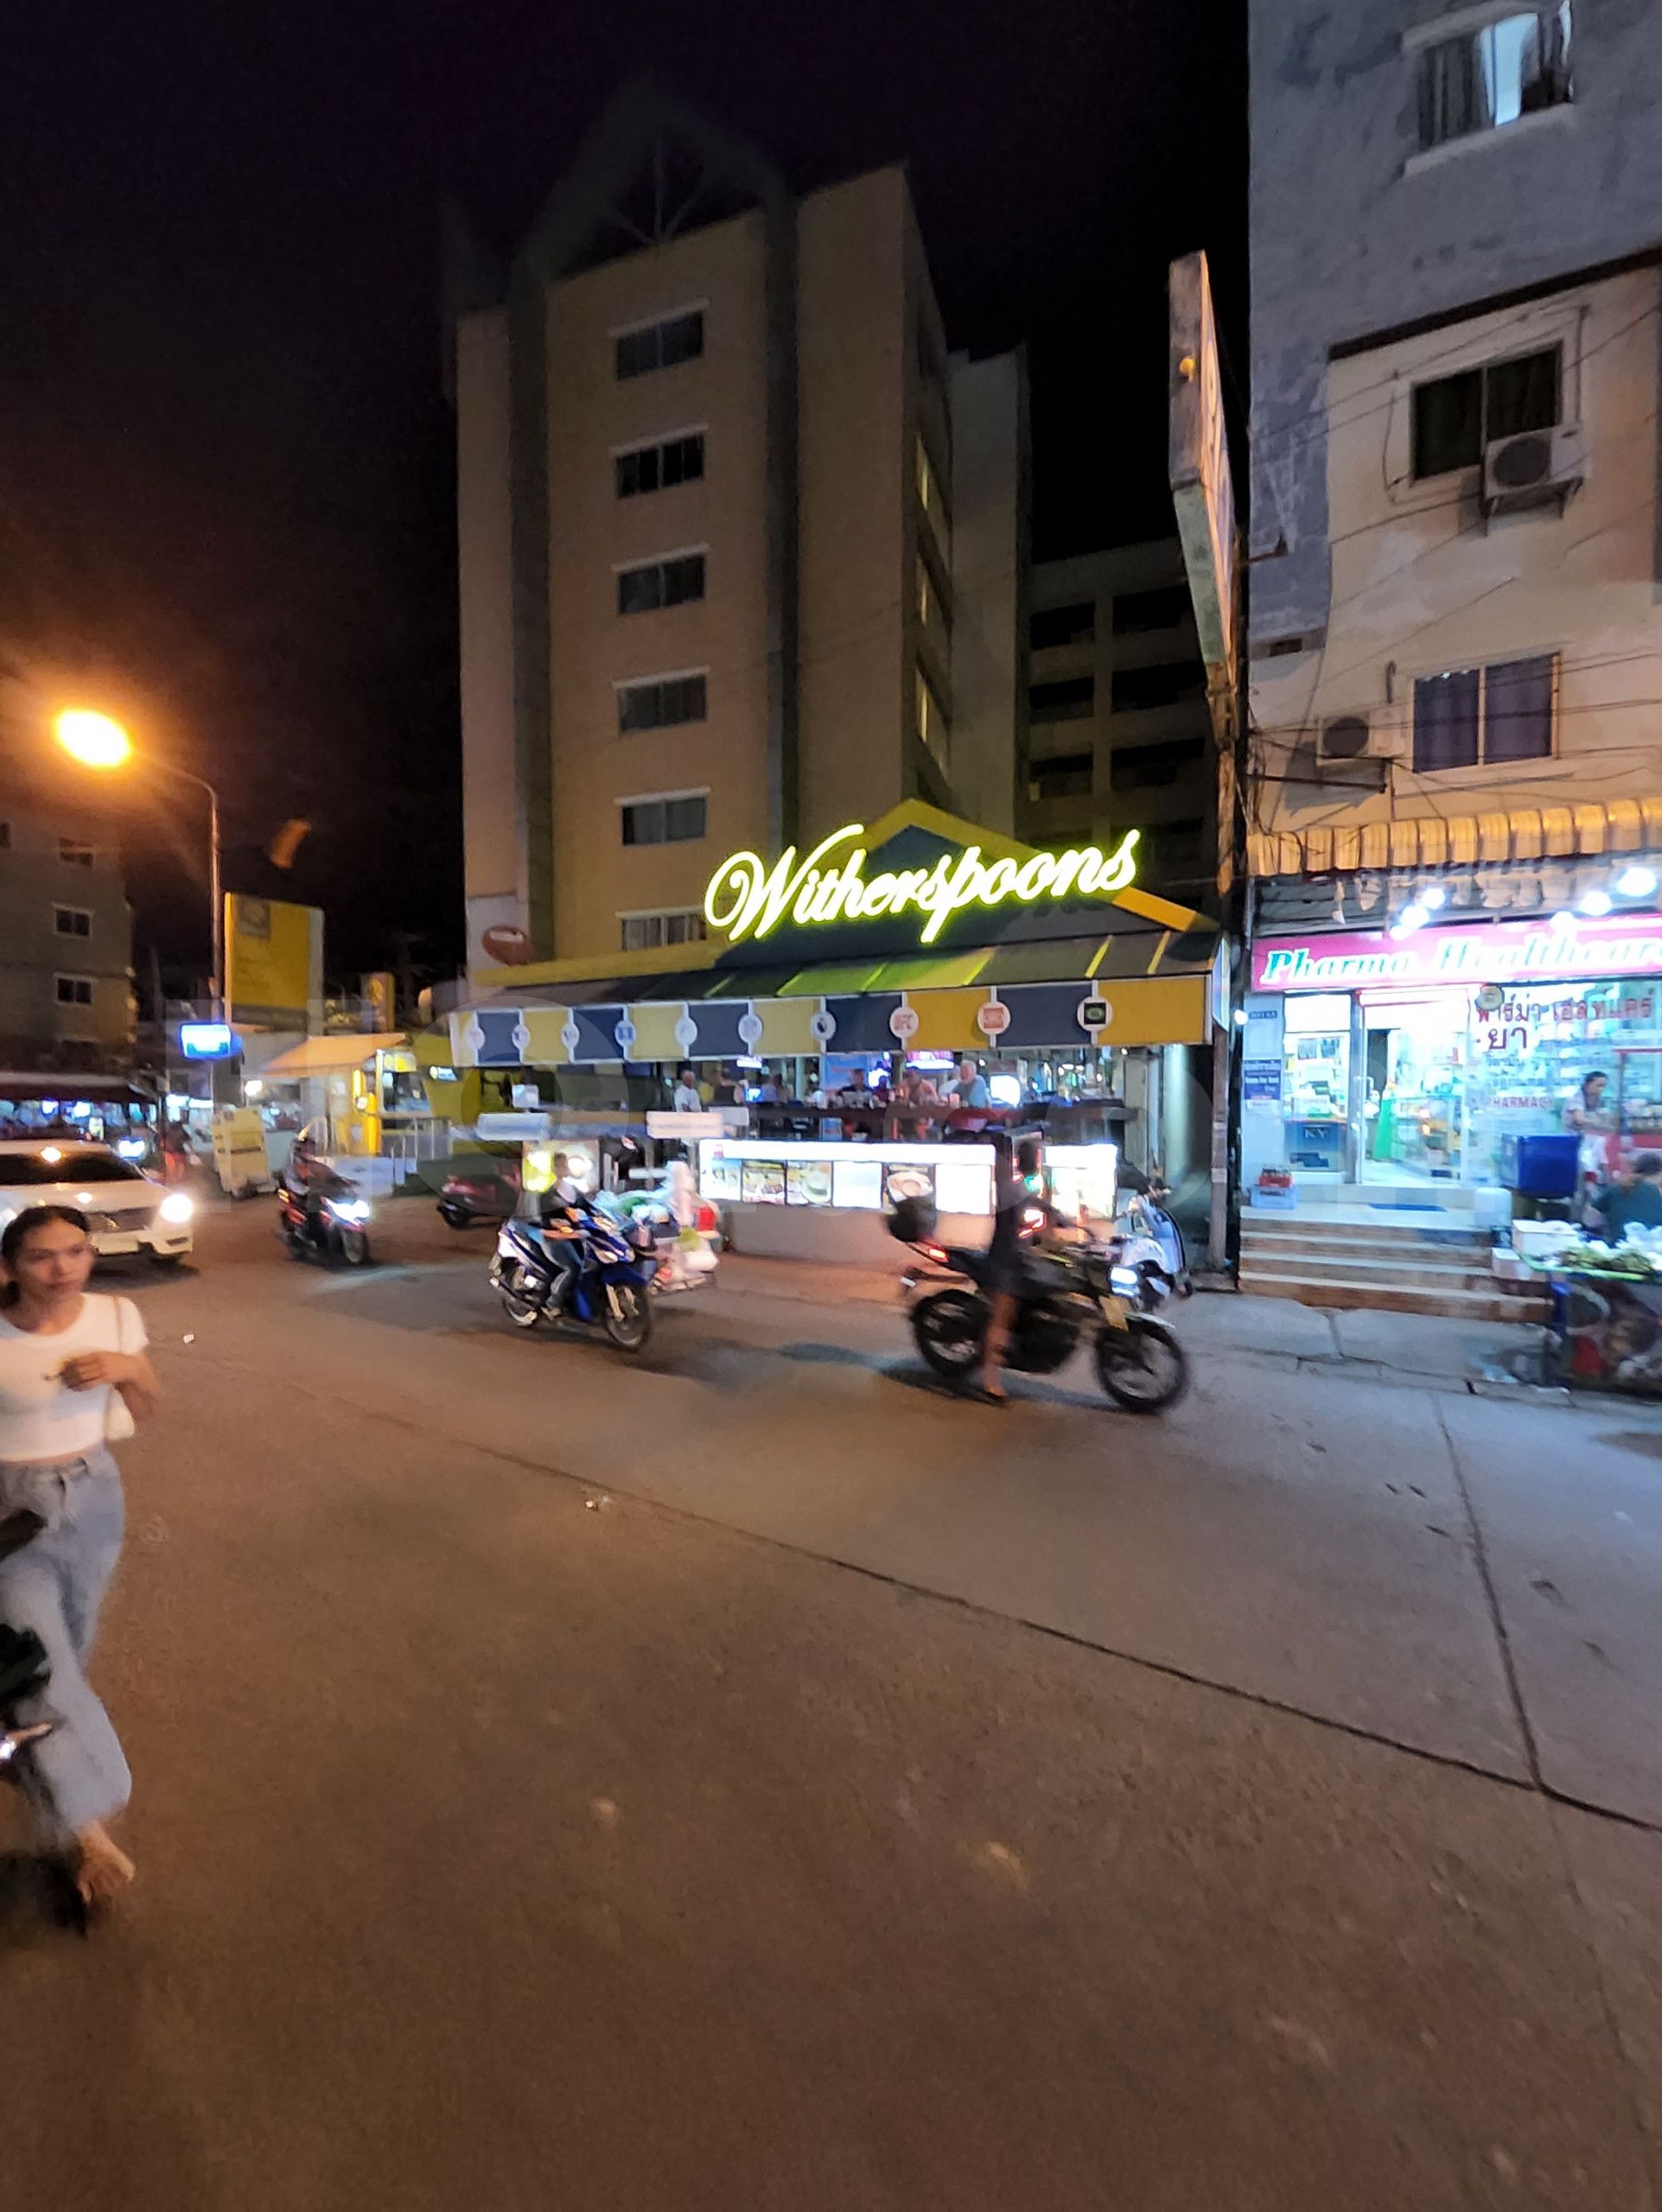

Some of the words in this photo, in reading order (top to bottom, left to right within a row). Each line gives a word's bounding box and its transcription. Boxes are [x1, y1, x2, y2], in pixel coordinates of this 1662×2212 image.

[704, 823, 1140, 943] Witherspoons
[1261, 949, 1414, 982] Pharma
[1435, 932, 1662, 975] Healthcar
[1487, 1027, 1527, 1050] ยา
[1304, 1128, 1328, 1139] KY
